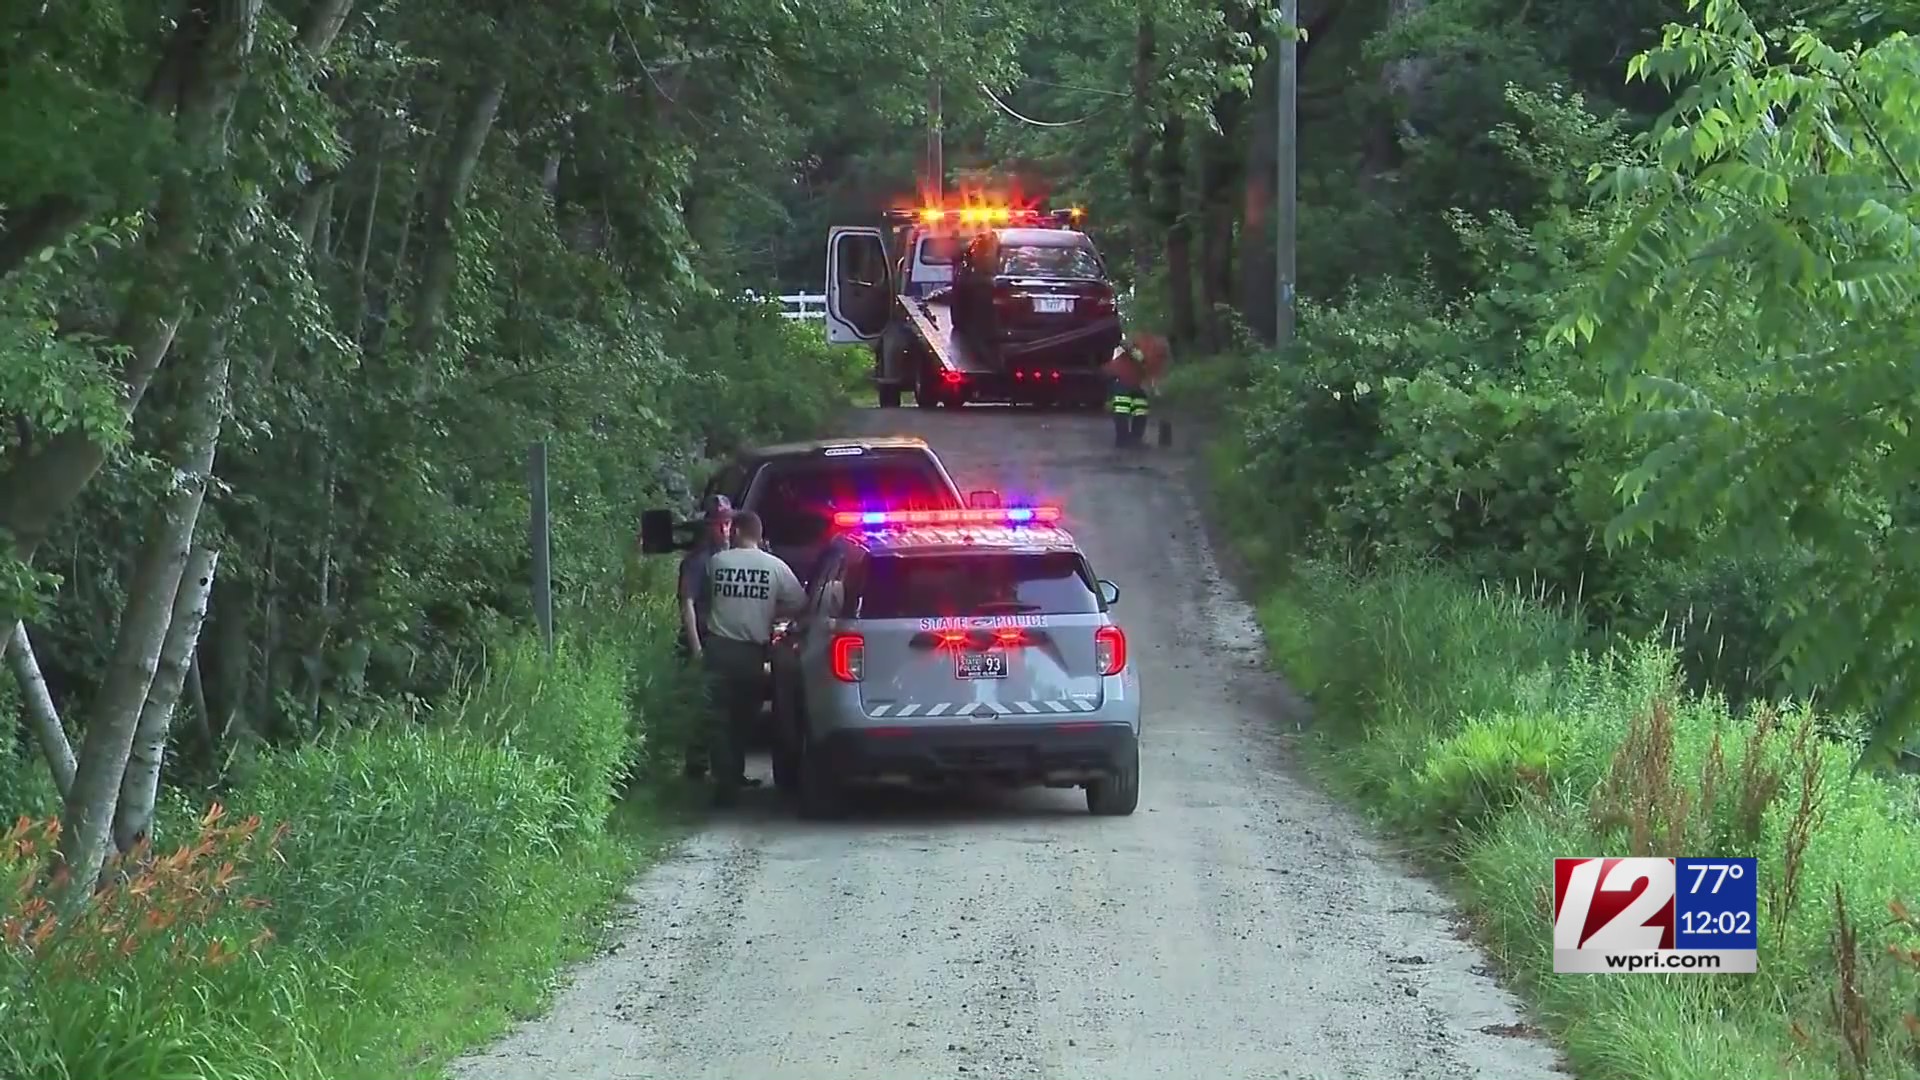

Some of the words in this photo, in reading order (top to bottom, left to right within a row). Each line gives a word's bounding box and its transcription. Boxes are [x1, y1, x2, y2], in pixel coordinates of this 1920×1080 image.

[715, 568, 770, 584] STATE
[714, 583, 770, 600] POLICE
[920, 617, 968, 630] STATE
[993, 615, 1048, 628] POLICE
[986, 657, 1001, 671] 93
